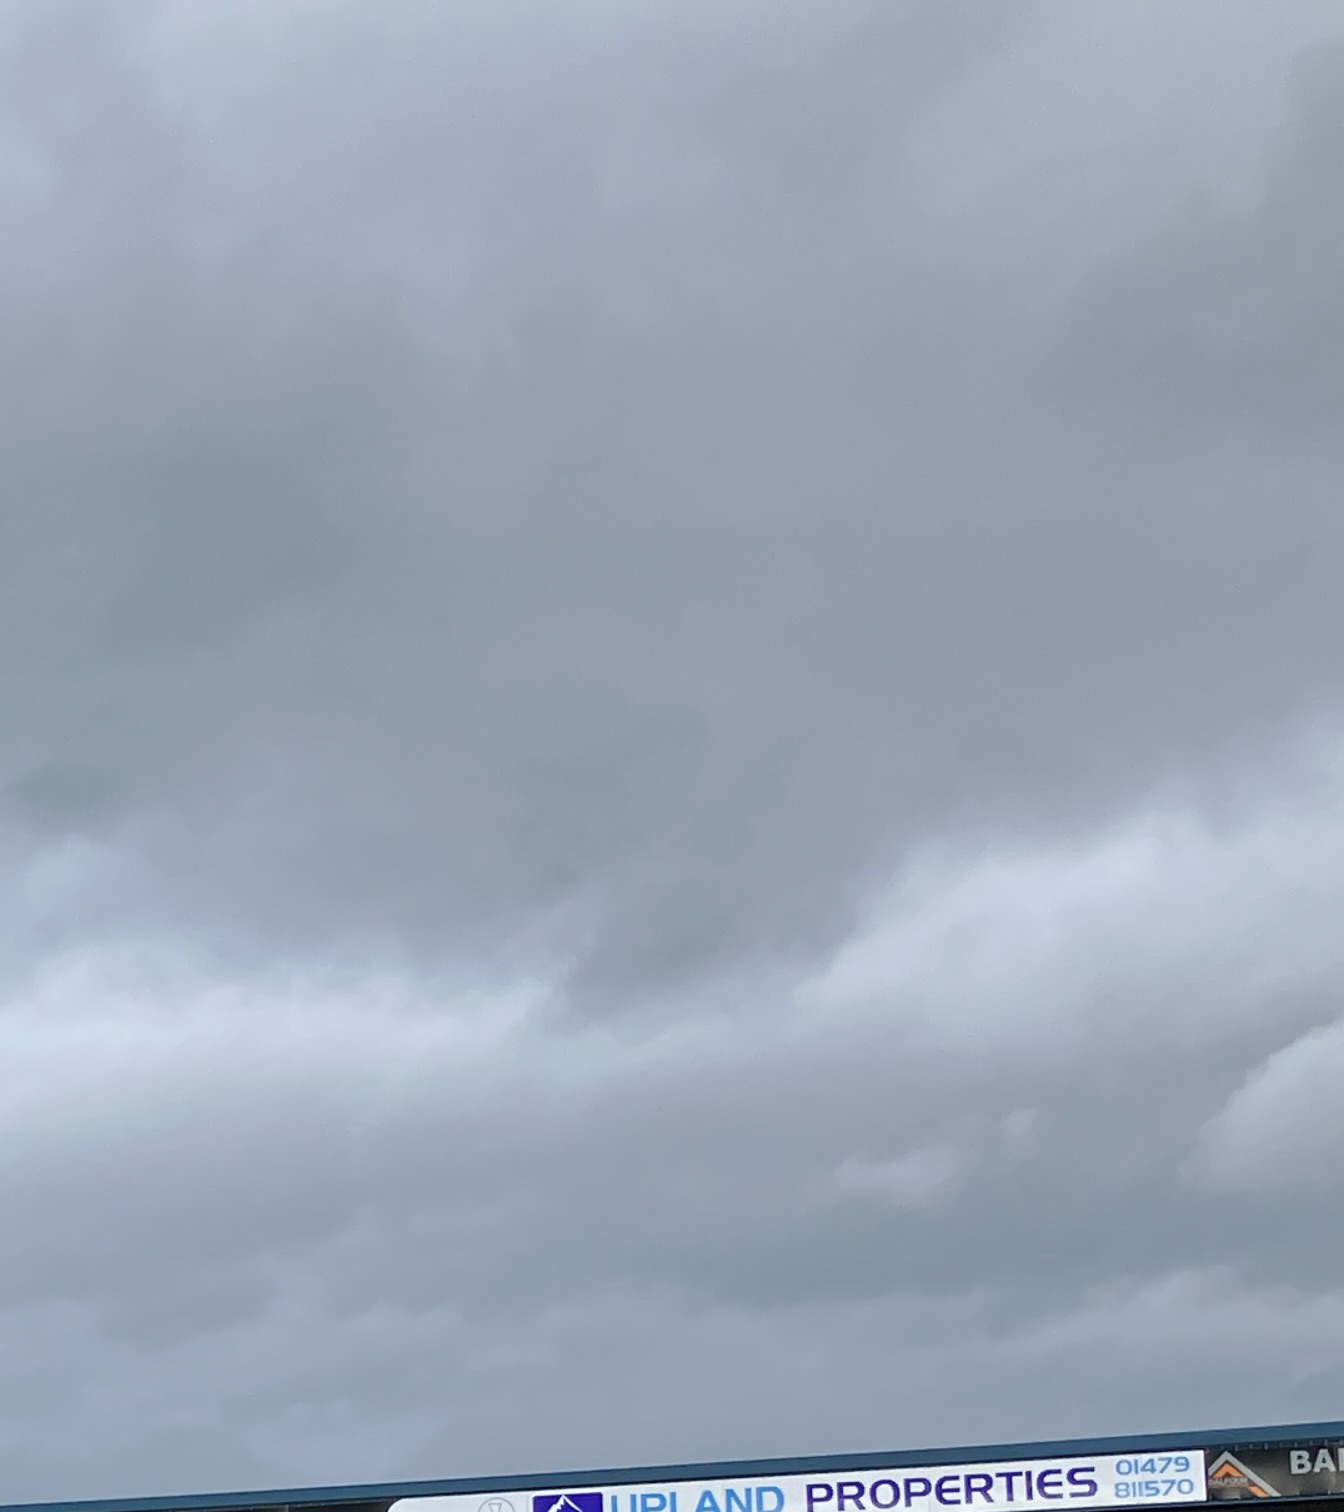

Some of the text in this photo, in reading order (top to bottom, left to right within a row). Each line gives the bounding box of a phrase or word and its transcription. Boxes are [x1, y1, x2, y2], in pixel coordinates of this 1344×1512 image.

[1115, 1456, 1190, 1475] 01479
[805, 1466, 1098, 1512] PROPERTIES
[1114, 1478, 1195, 1498] 811570
